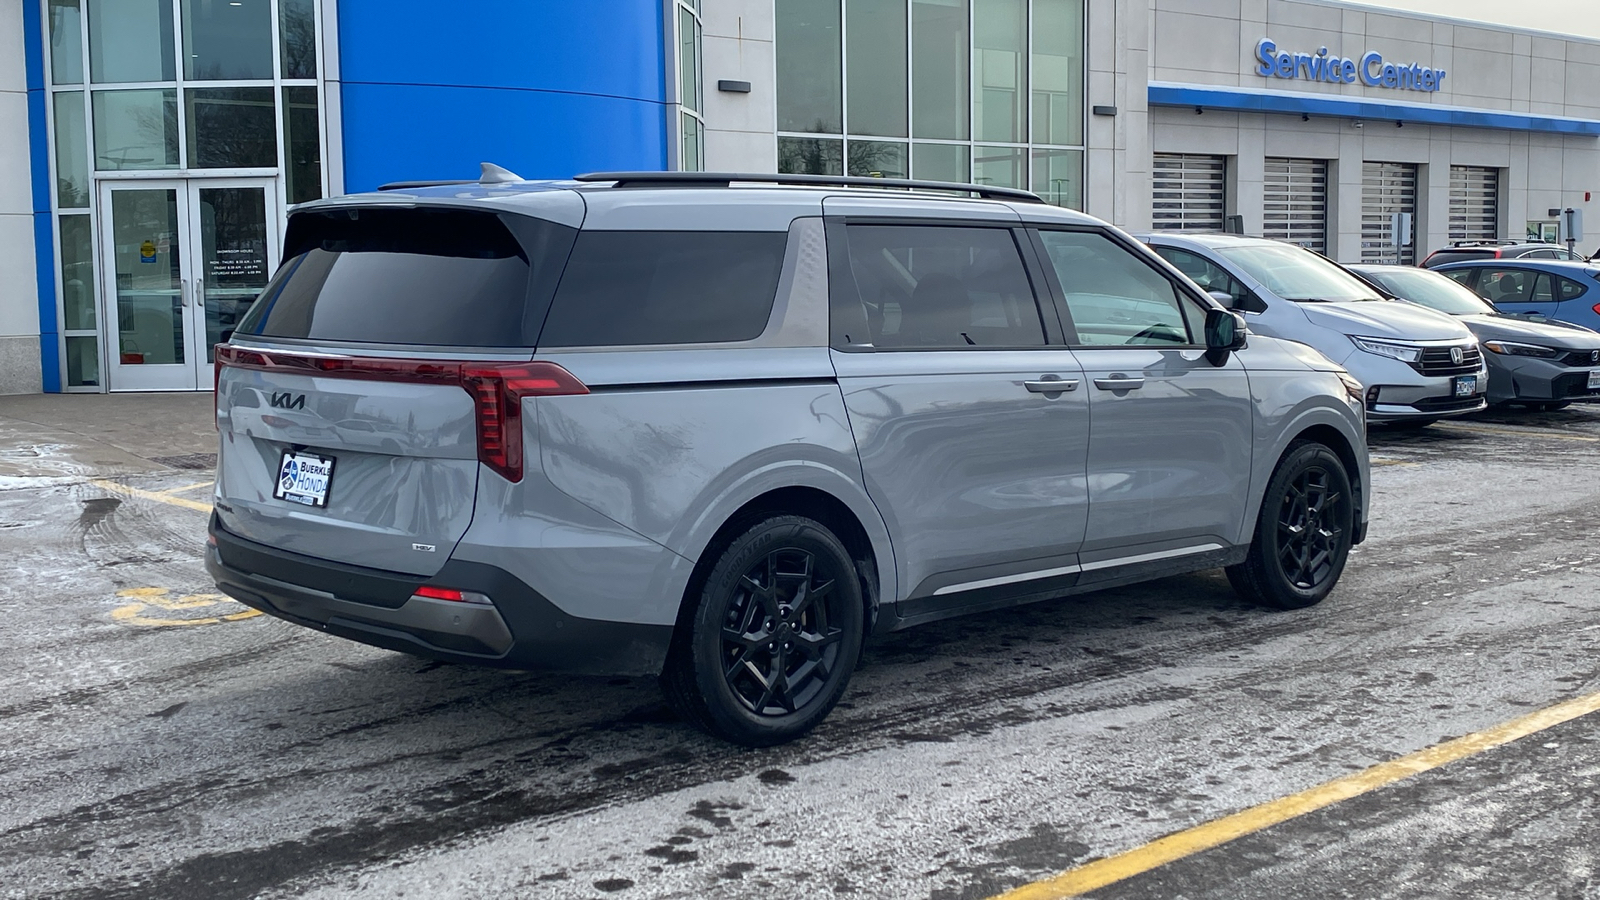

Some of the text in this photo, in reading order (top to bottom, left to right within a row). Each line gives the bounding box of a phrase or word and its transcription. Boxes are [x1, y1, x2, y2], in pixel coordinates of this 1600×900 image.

[1255, 37, 1447, 92] Service Center
[271, 391, 306, 410] KIA
[300, 461, 330, 476] BUERKLE
[296, 473, 328, 493] HONDA
[721, 533, 772, 587] GOODYEAR
